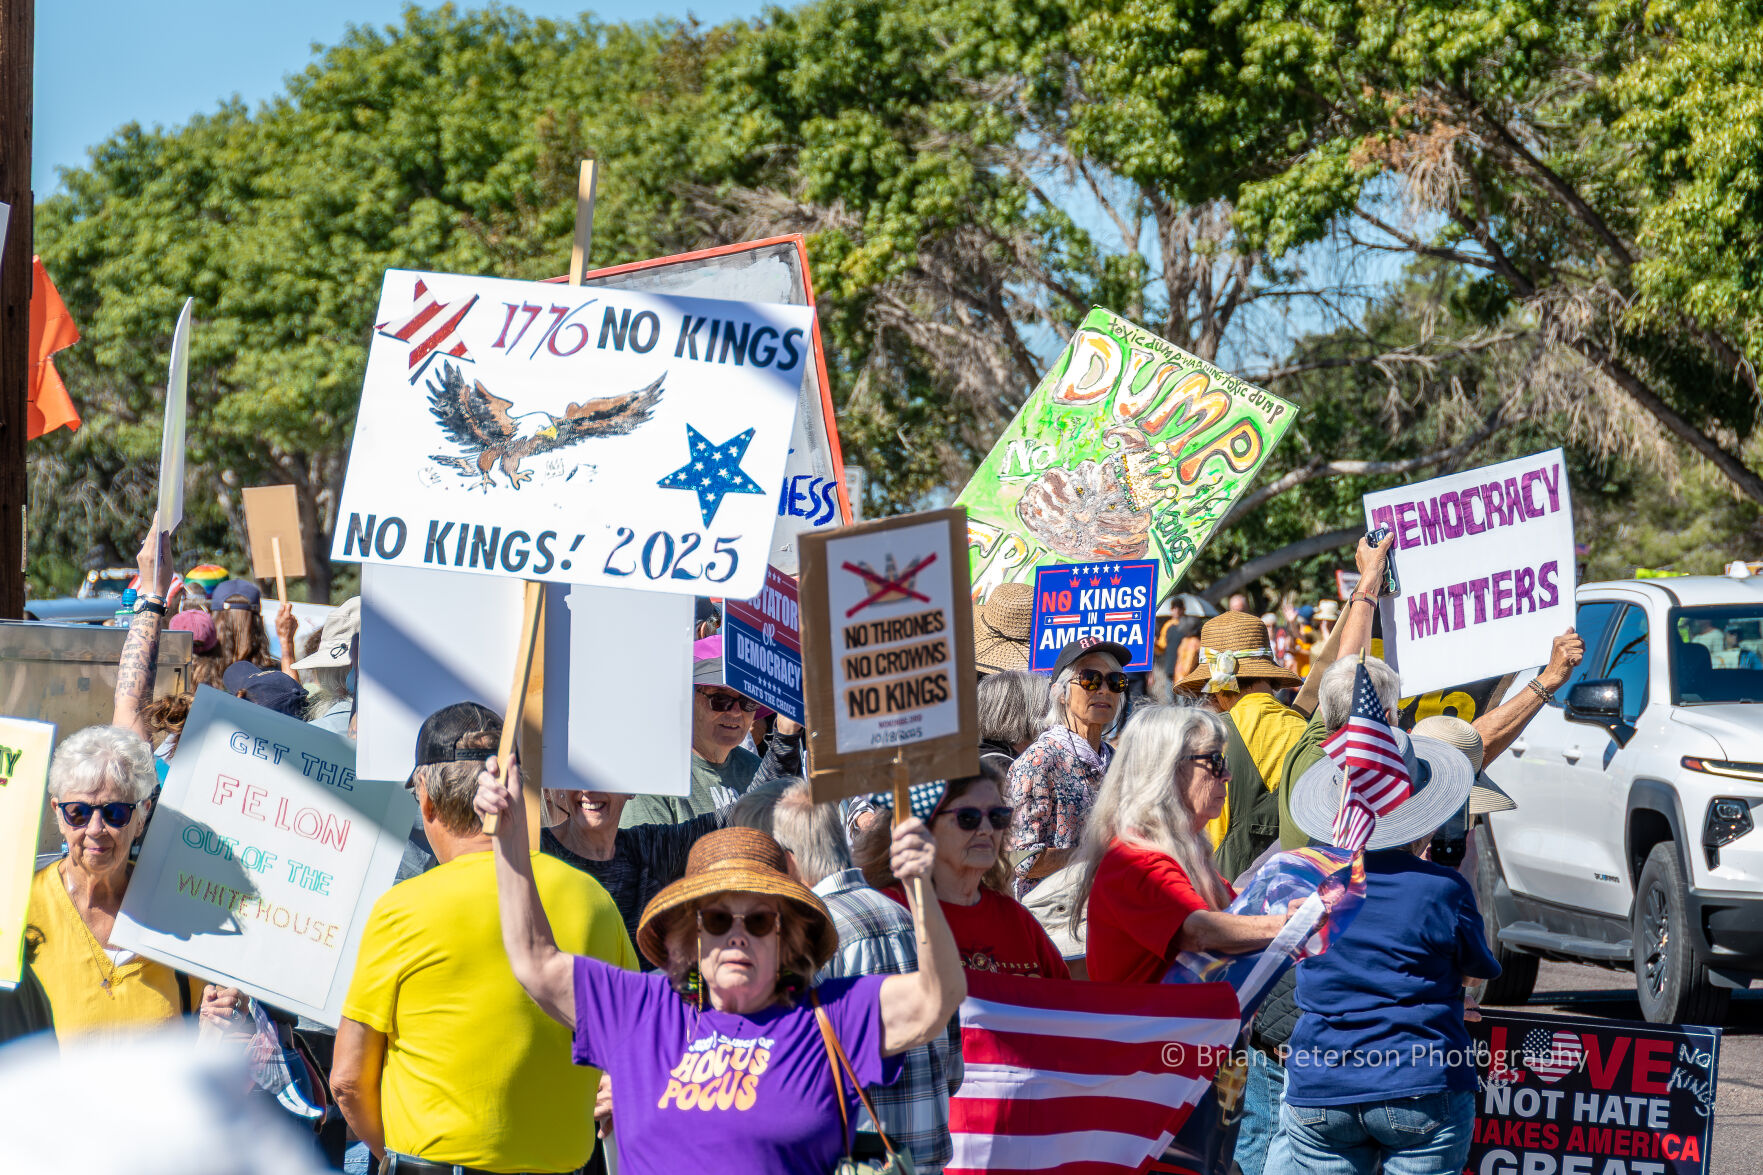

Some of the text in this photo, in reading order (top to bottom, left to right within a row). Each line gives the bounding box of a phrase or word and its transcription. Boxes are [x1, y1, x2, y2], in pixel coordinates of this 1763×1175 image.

[491, 298, 804, 371] 1776 NO KINGS
[1052, 326, 1264, 486] DUMP
[1371, 463, 1561, 551] DEMOCRACY
[343, 512, 743, 583] NO KINGS! 2025
[748, 584, 798, 633] TATOR
[1042, 585, 1147, 613] NO KINGS
[1087, 612, 1098, 625] IN
[1407, 560, 1559, 641] MATTERS
[845, 610, 945, 649] NO THRONES
[1039, 624, 1143, 650] AMERICA
[736, 633, 801, 692] DEMOCRACY
[847, 642, 946, 680] NO CROWNS
[764, 690, 776, 706] THE
[776, 697, 797, 717] CHOICE
[849, 673, 948, 718] NO KINGS
[230, 731, 357, 791] GET THE
[212, 773, 351, 853] FELON
[182, 824, 334, 897] OUT OF THE
[670, 1044, 771, 1084] HOCUS
[657, 1071, 759, 1111] POCUS
[1485, 1084, 1671, 1129] NOT HATE
[1566, 1126, 1701, 1163] AMERICA
